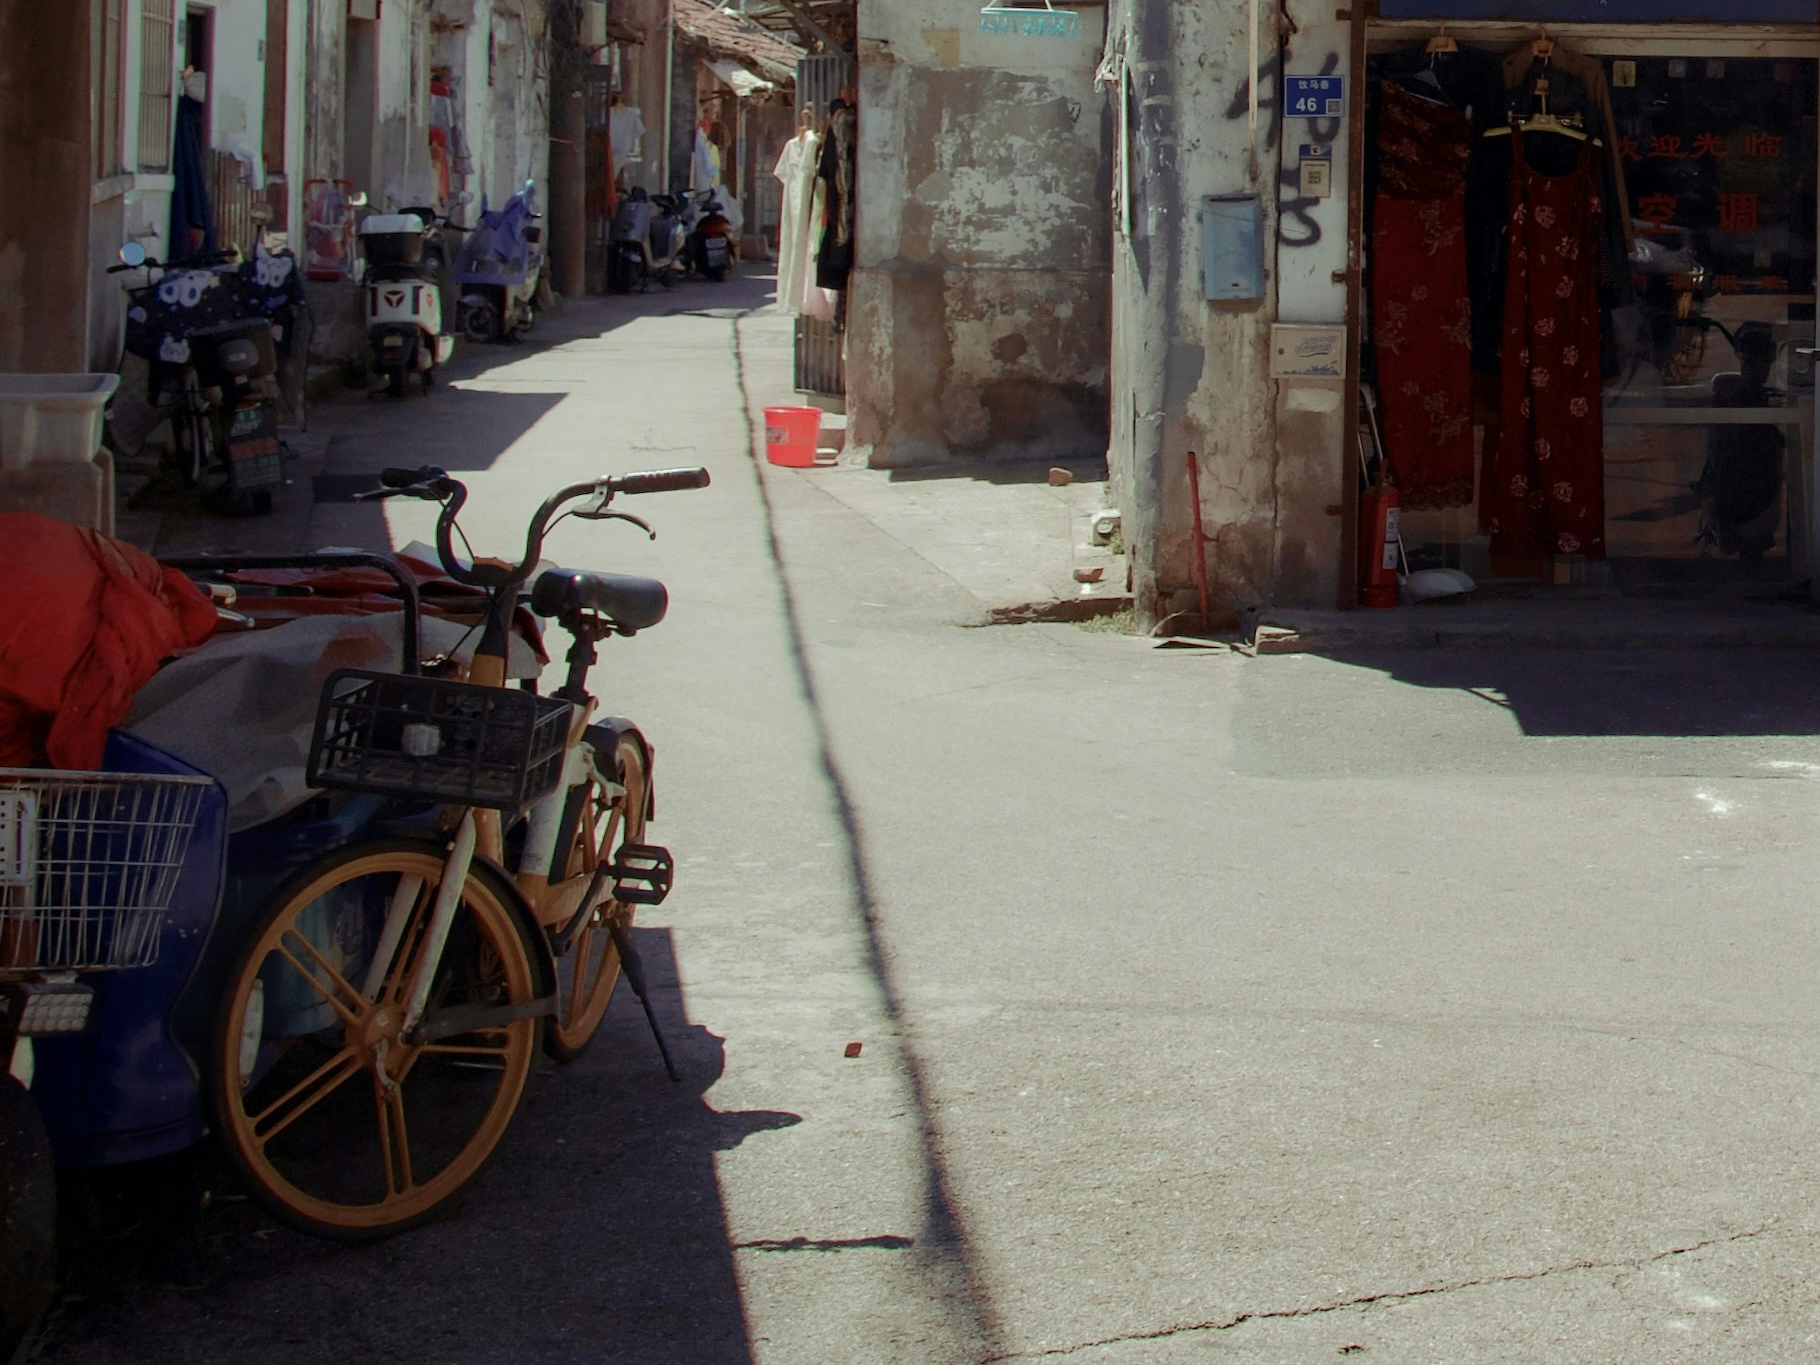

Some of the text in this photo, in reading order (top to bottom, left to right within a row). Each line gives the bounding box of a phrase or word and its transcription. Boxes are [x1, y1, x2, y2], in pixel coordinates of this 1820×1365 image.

[1297, 79, 1330, 90] 饮马巷
[1296, 97, 1318, 112] 46
